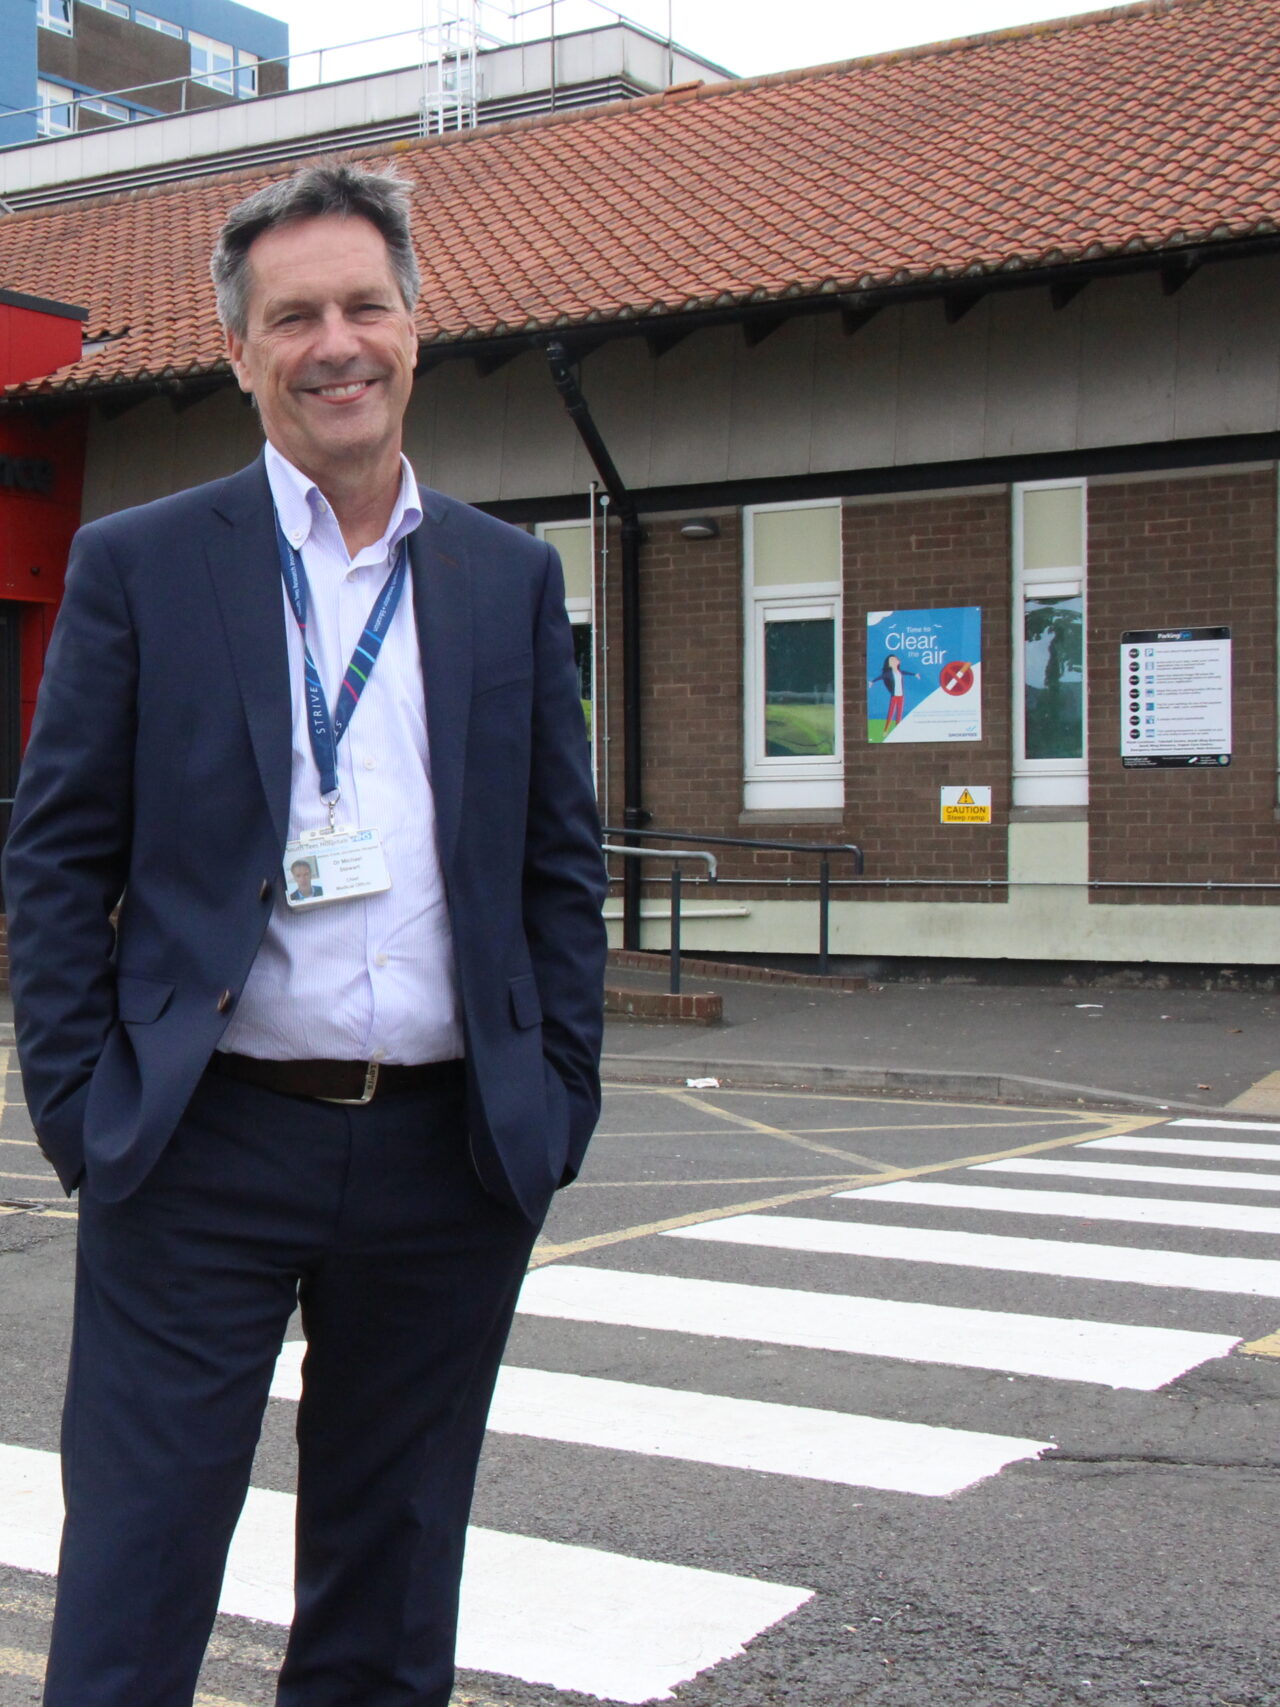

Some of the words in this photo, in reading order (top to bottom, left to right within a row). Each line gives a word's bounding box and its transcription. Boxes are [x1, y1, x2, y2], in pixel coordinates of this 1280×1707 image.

[921, 646, 947, 665] air
[310, 686, 326, 735] STRIVE
[945, 806, 986, 814] CAUTION
